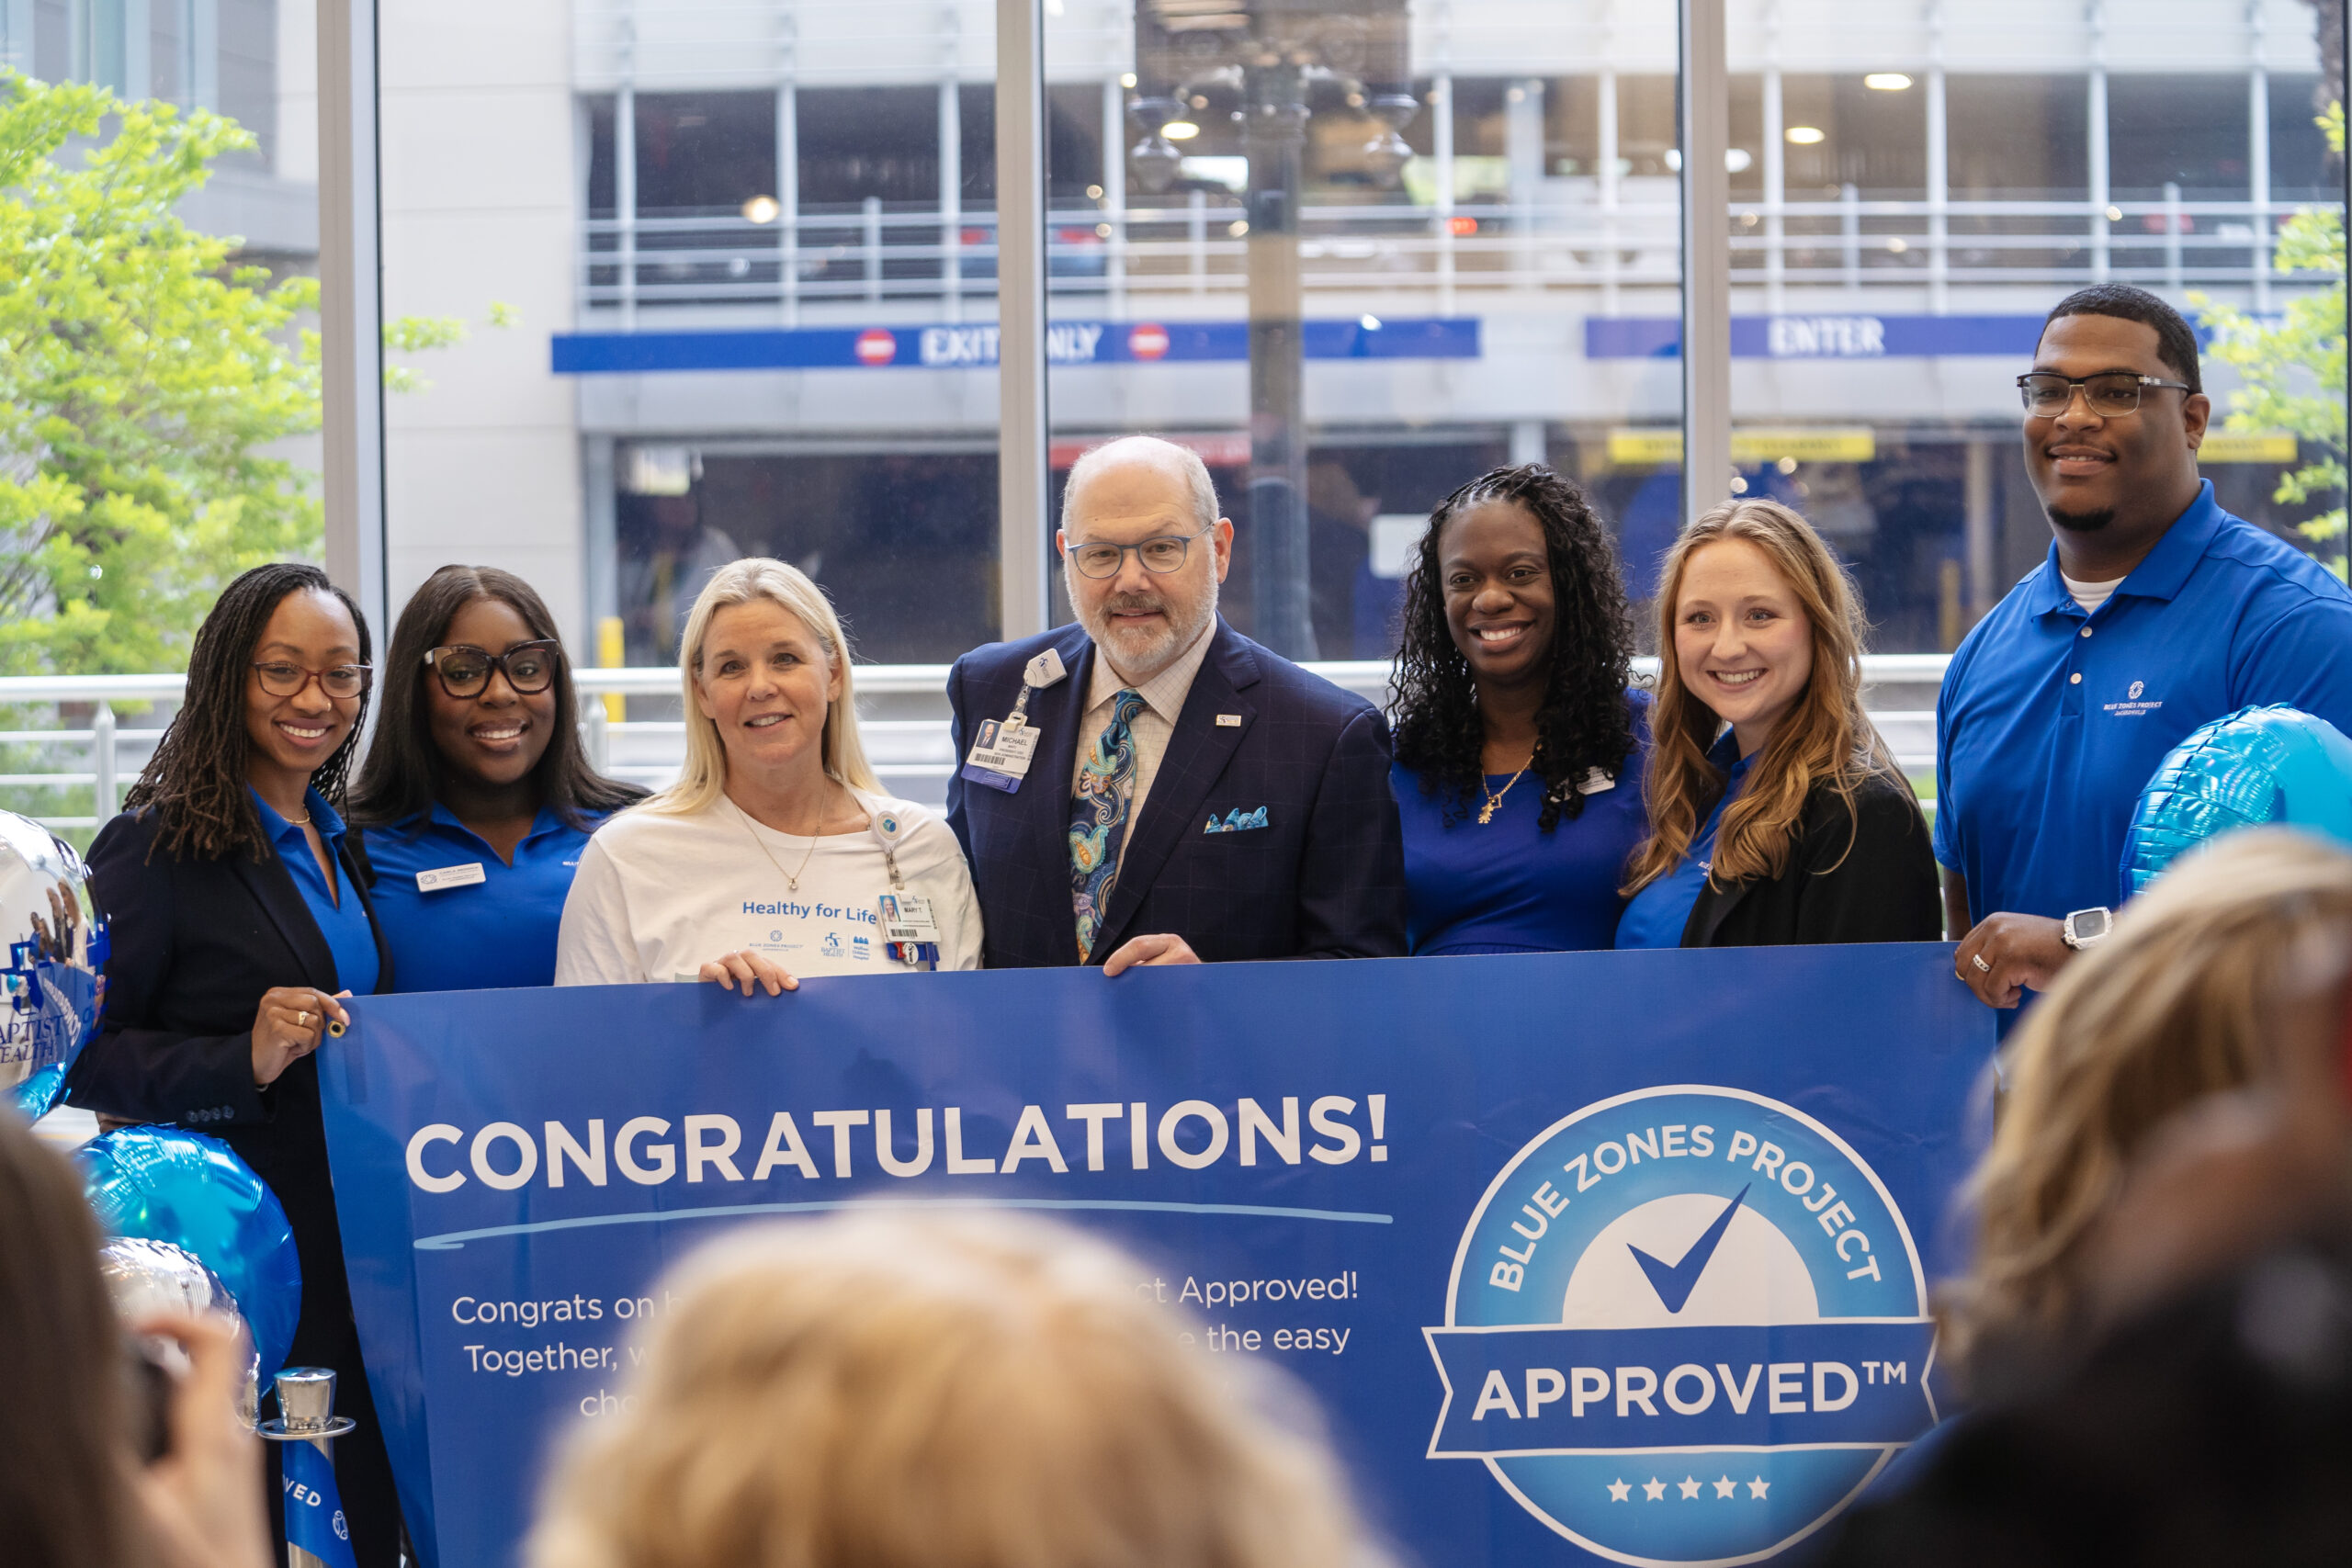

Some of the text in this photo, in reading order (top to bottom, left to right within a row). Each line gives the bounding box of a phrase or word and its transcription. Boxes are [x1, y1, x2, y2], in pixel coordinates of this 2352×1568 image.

[922, 324, 1103, 363] EXIT NLY
[1768, 318, 1886, 355] ENTER
[1001, 736, 1027, 746] MICHAEL
[742, 901, 877, 925] Healthy for Life
[0, 1015, 64, 1044] APTIST
[0, 1040, 54, 1064] EALTH
[405, 1094, 1388, 1193] CONGRATULATIONS!
[1488, 1124, 1882, 1292] BLUE ZONES PROJECT
[1179, 1270, 1358, 1308] Approved!
[452, 1294, 604, 1328] Congrats
[615, 1297, 655, 1319] on
[1206, 1324, 1261, 1352] the
[1273, 1327, 1351, 1355] easy
[463, 1342, 617, 1377] Together,
[580, 1389, 640, 1417] cho
